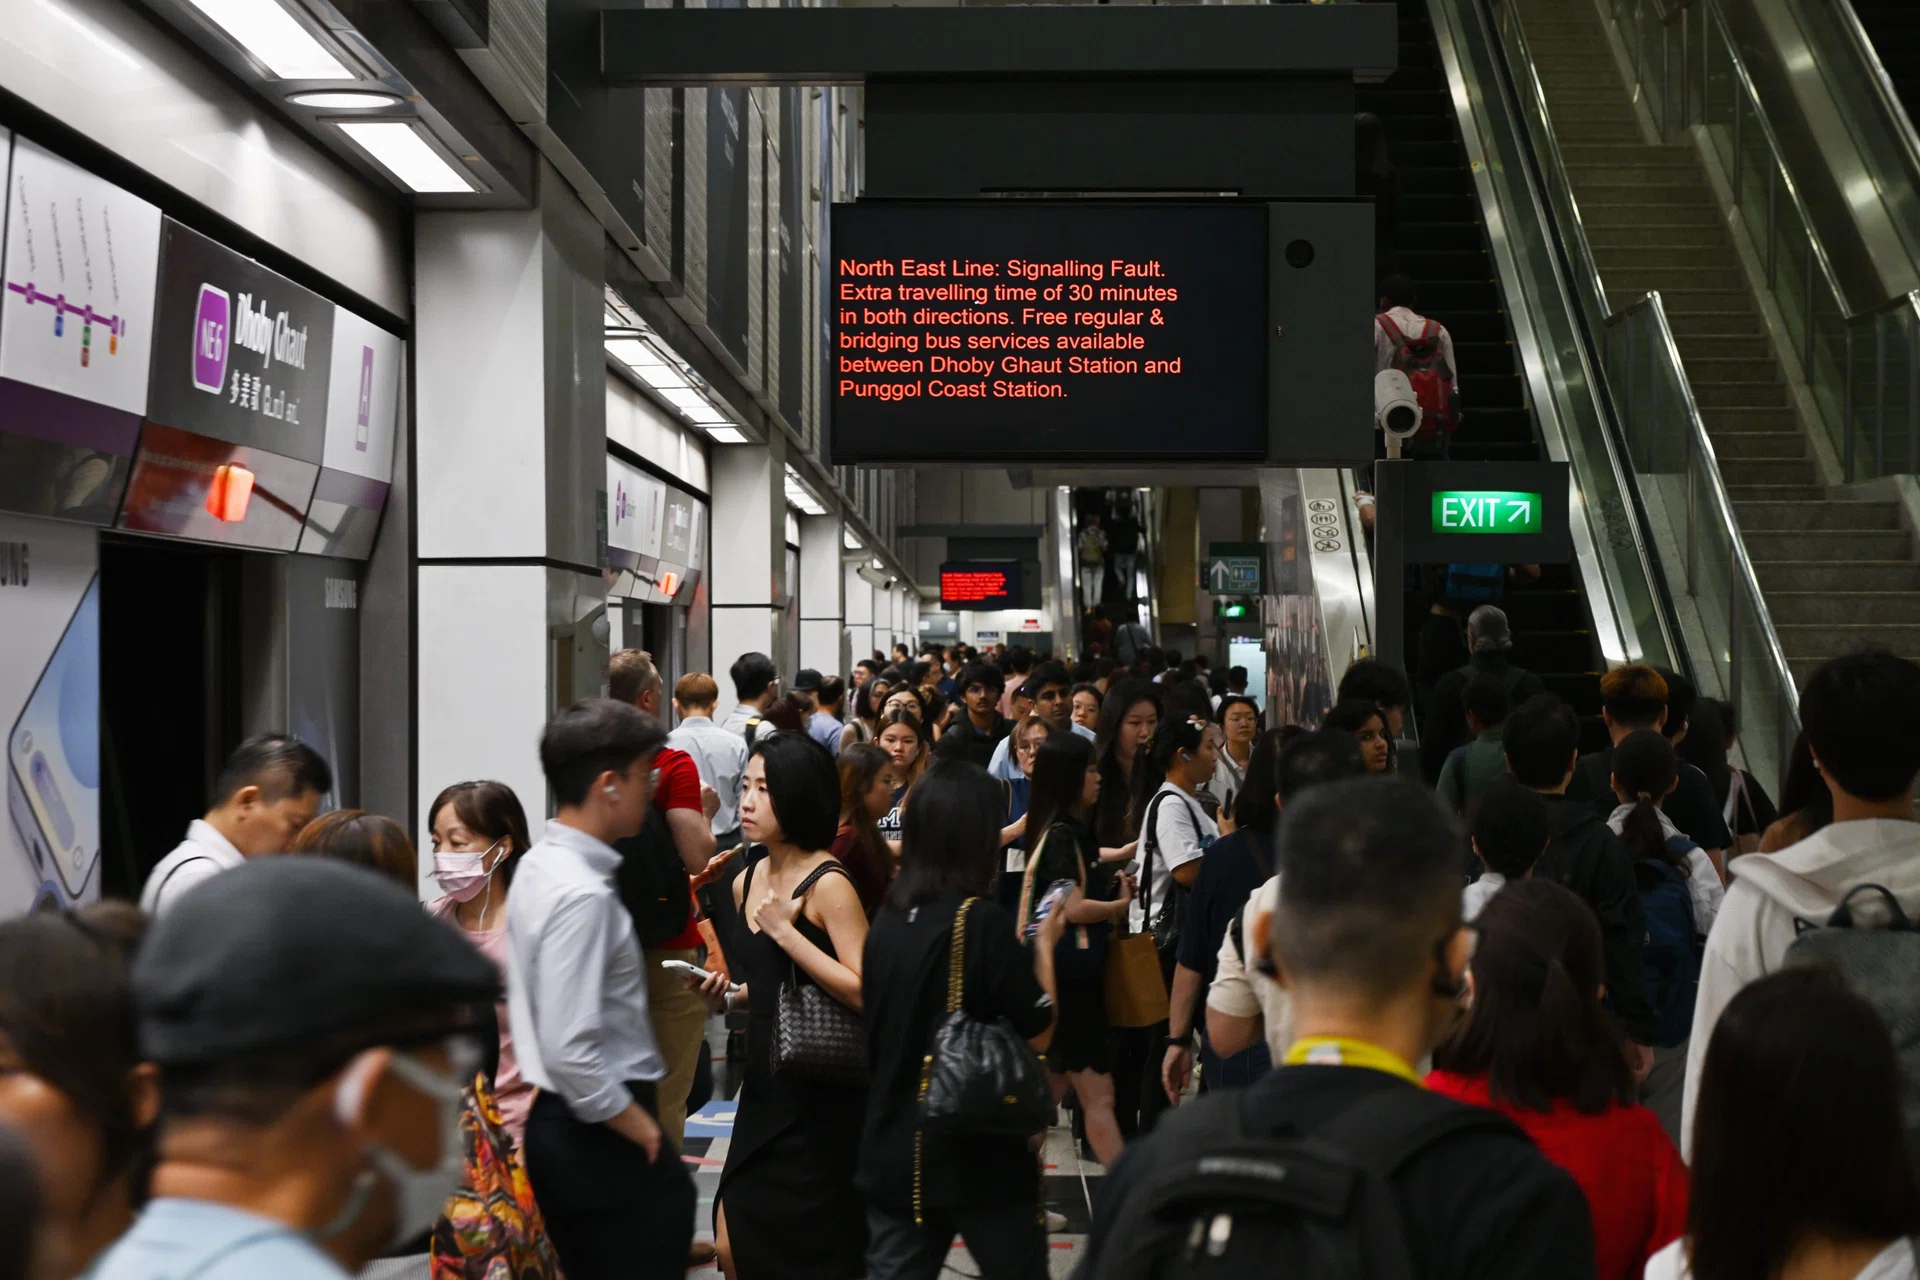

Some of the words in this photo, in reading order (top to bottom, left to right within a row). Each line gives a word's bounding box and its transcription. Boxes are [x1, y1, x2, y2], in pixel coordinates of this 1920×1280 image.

[840, 260, 894, 276] North
[902, 260, 946, 276] East
[953, 260, 999, 276] Line:
[1007, 260, 1103, 281] Signalling
[1112, 260, 1165, 277] Fault.
[841, 284, 892, 300] Extra
[898, 284, 988, 304] travelling
[994, 284, 1037, 301] time
[1044, 284, 1063, 301] of
[1069, 284, 1093, 301] 30
[1100, 285, 1178, 301] minutes
[840, 308, 857, 324] in
[864, 308, 906, 324] both
[913, 308, 1014, 325] directions.
[1023, 308, 1068, 325] Free
[1075, 309, 1144, 329] regular
[1150, 308, 1164, 325] &
[201, 318, 224, 362] NE6
[235, 292, 275, 369] Dhoby
[274, 311, 308, 370] Ghaut
[840, 332, 918, 352] bridging
[926, 332, 961, 348] bus
[968, 332, 1050, 349] services
[1057, 333, 1144, 349] available
[840, 356, 923, 372] between
[931, 356, 995, 377] Dhoby
[1002, 356, 1062, 373] Ghaut
[1069, 356, 1137, 373] Station
[1145, 357, 1181, 373] and
[840, 380, 921, 401] Punggol
[928, 380, 986, 397] Coast
[993, 380, 1067, 397] Station.
[1442, 498, 1501, 527] EXIT
